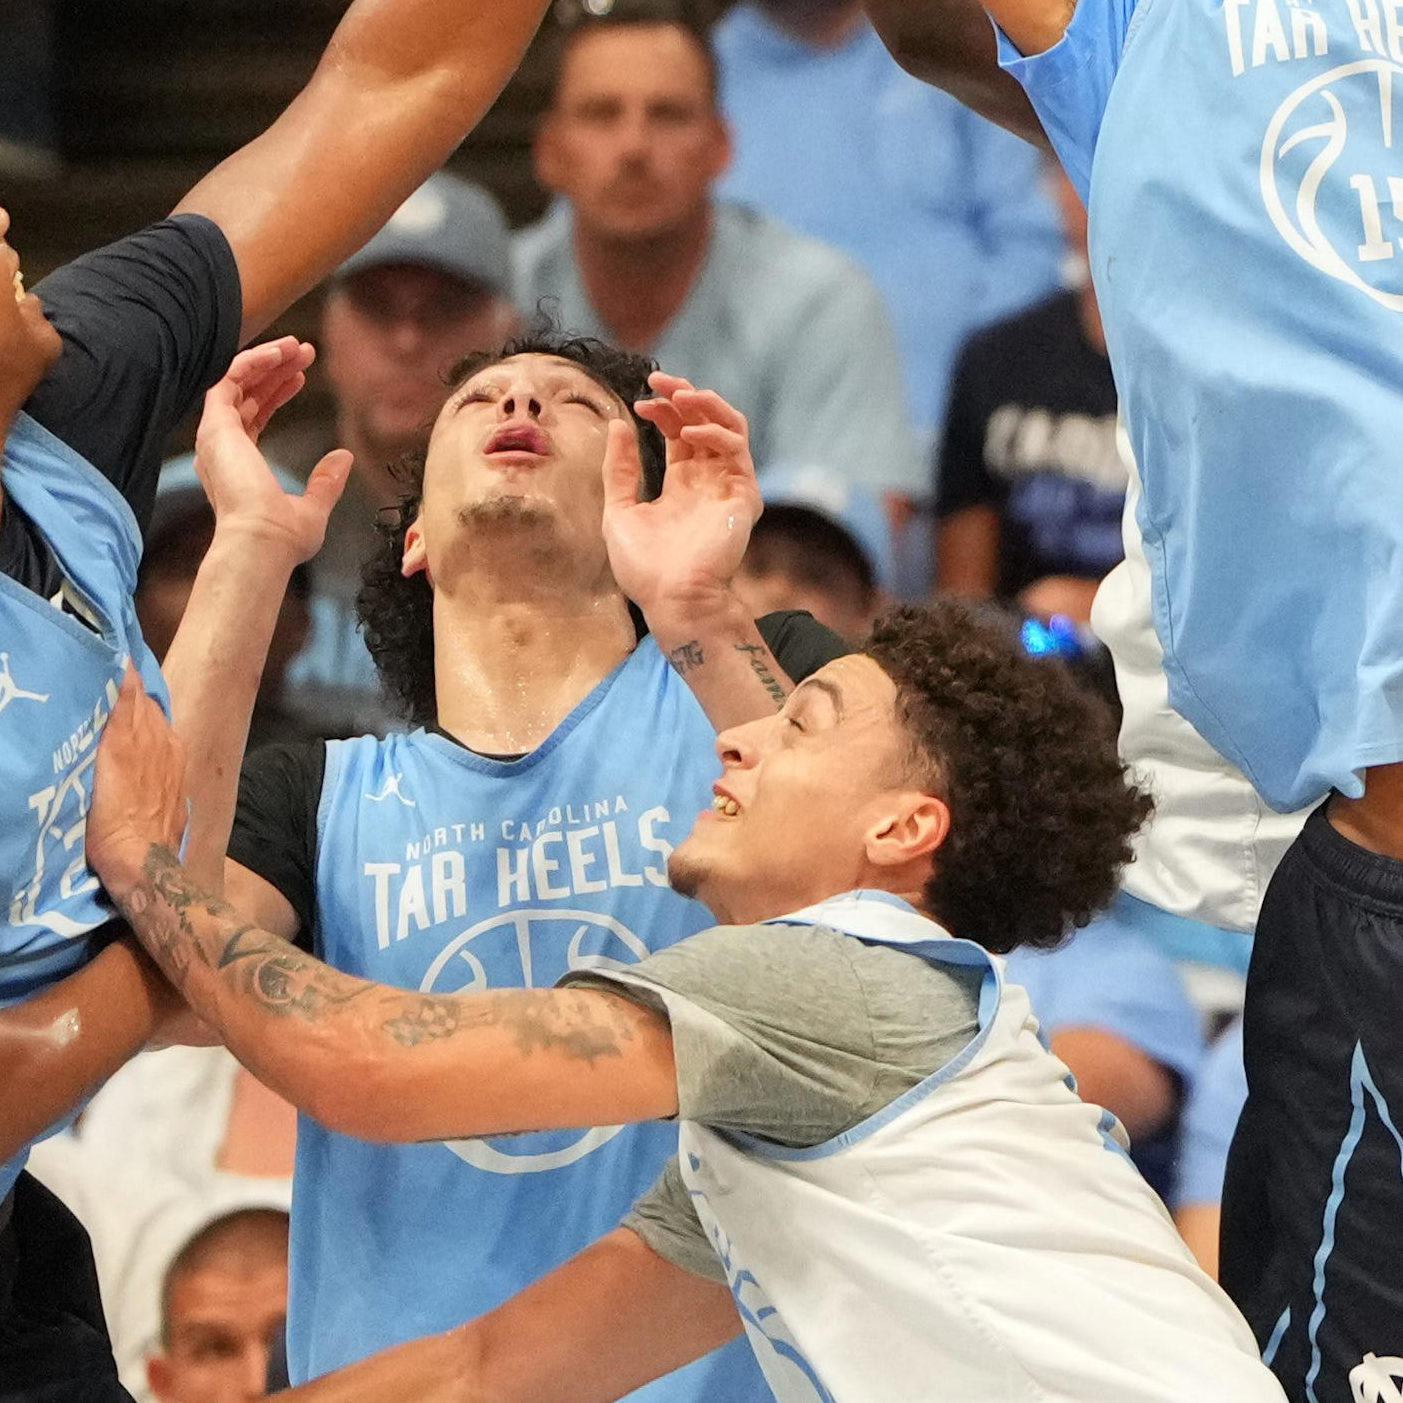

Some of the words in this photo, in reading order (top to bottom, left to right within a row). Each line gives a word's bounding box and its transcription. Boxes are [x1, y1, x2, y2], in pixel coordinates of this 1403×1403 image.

[364, 850, 467, 951] TAR
[496, 805, 673, 908] HEELS
[406, 822, 486, 861] NORTH
[501, 795, 629, 842] CAROLINA
